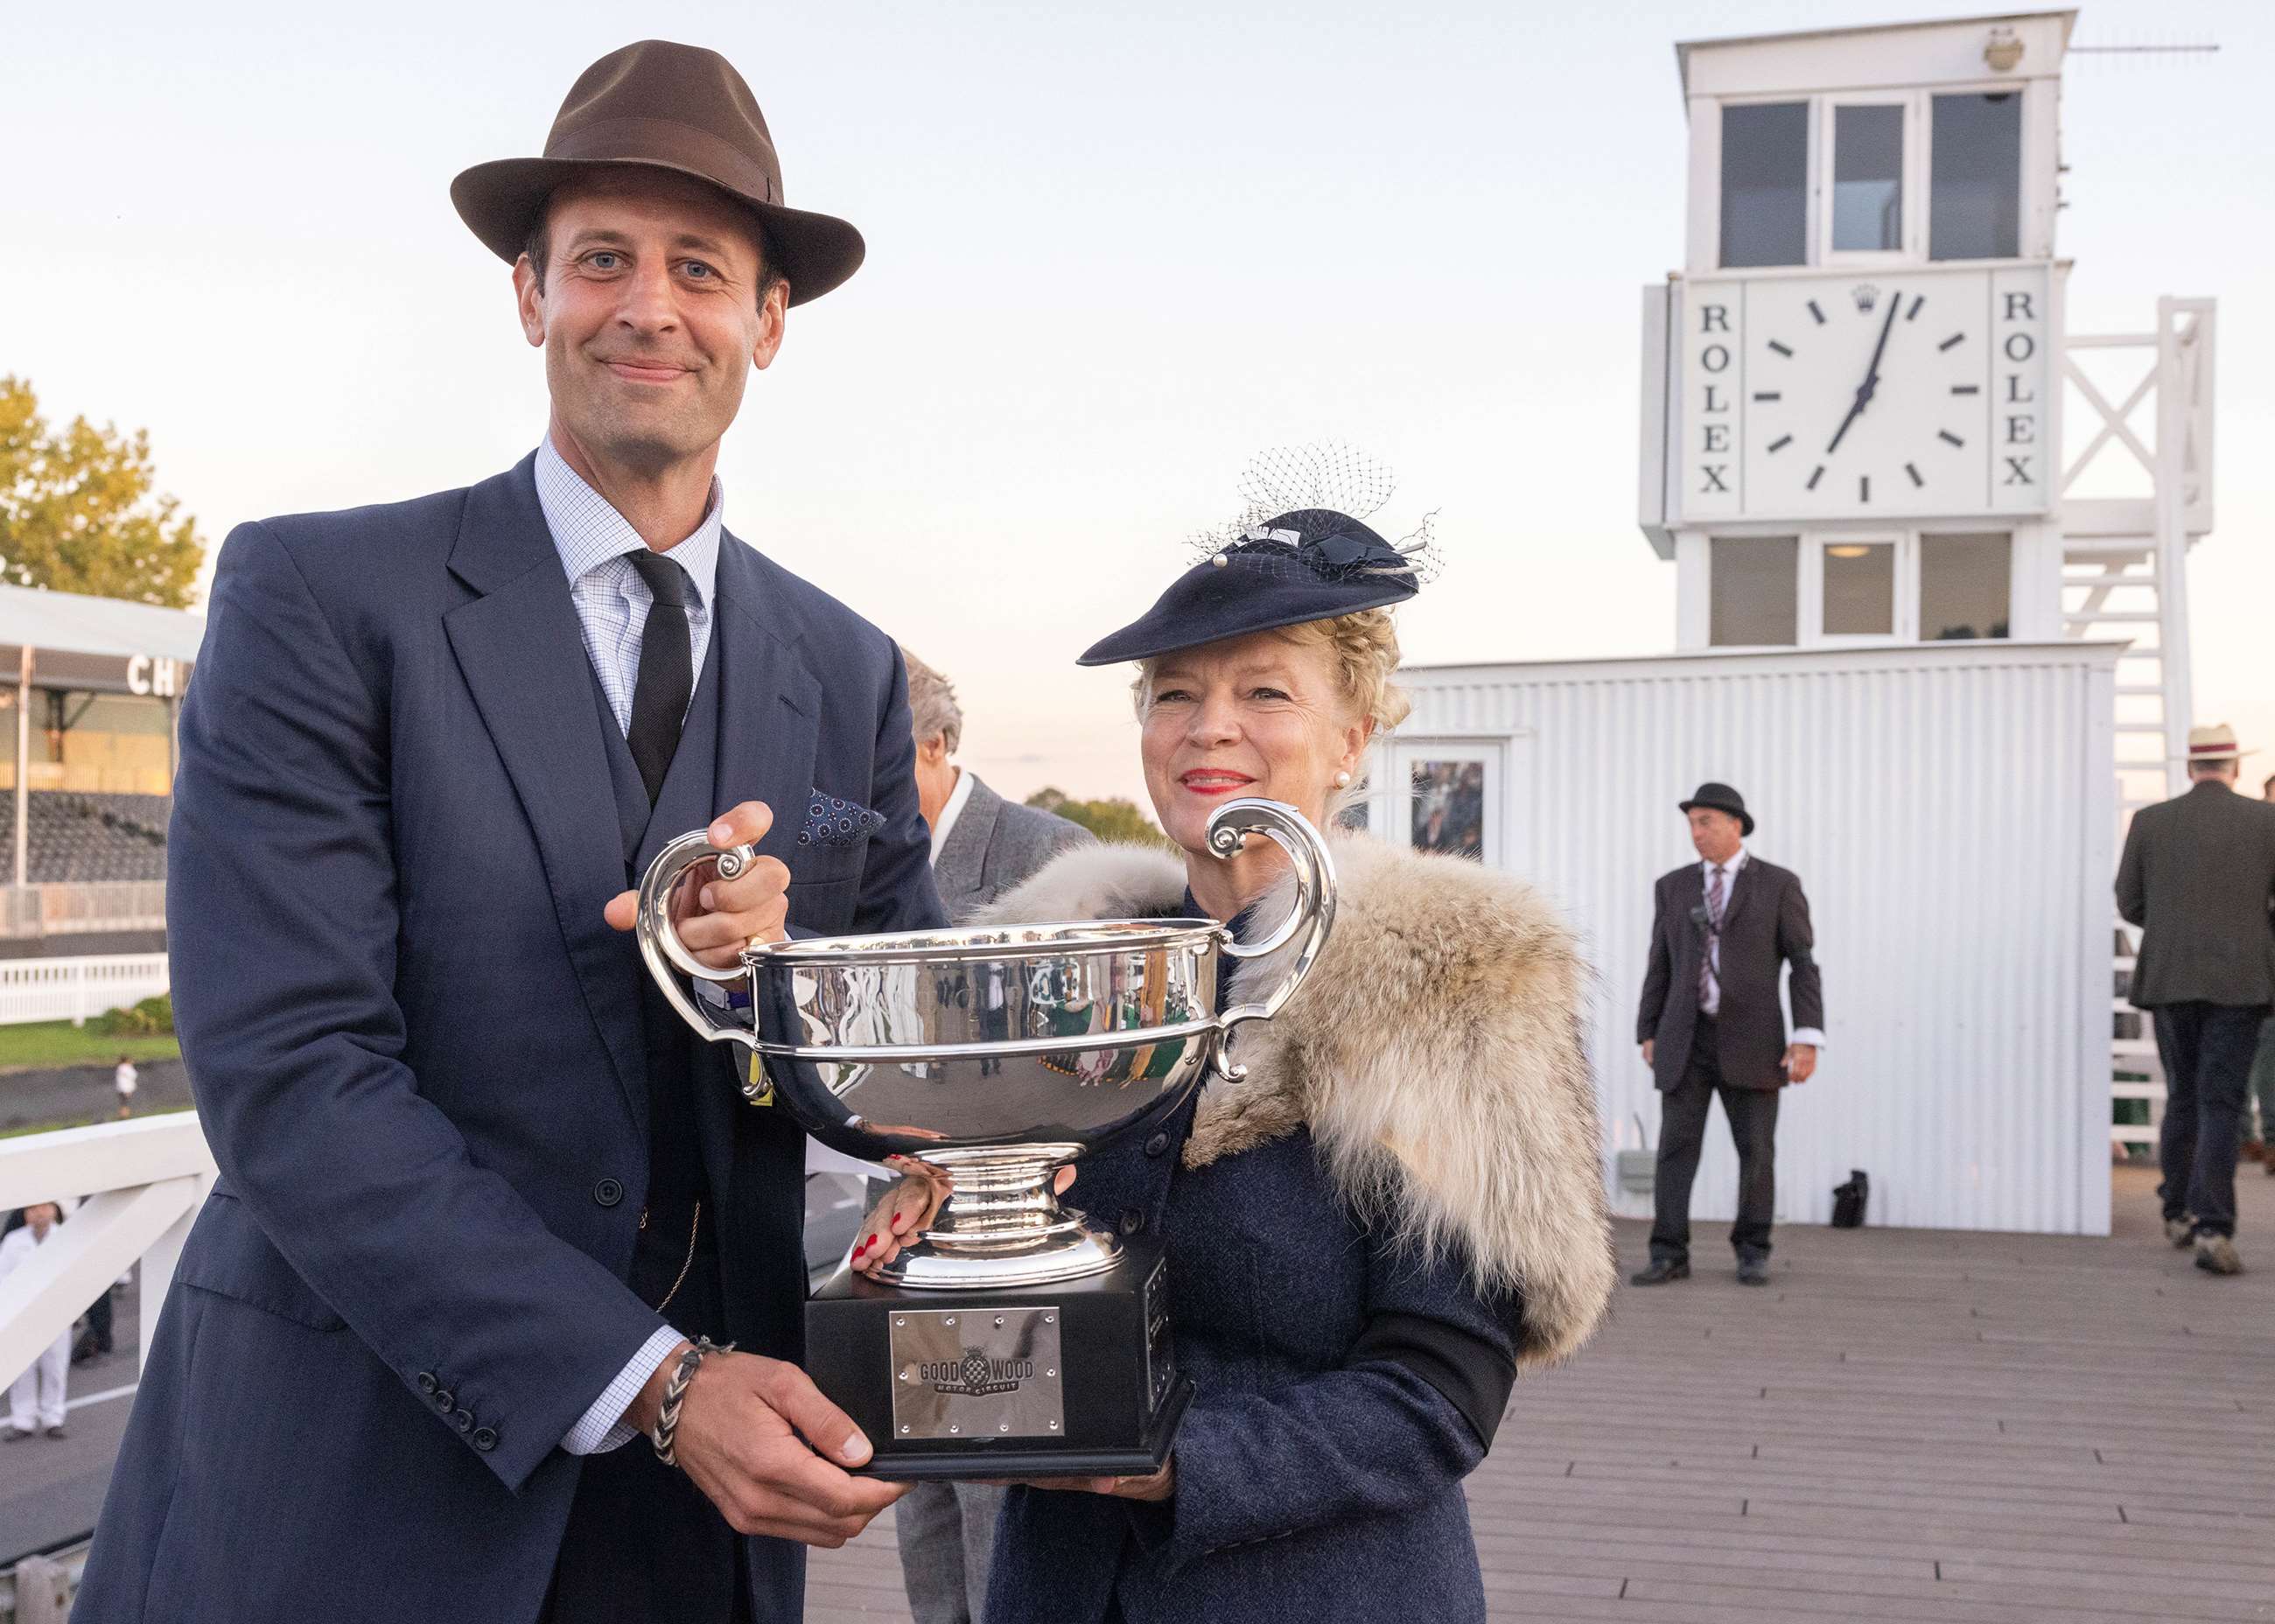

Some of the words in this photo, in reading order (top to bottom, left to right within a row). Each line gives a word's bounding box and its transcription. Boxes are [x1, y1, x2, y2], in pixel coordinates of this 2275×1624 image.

[1699, 304, 1731, 494] ROLEX
[2003, 290, 2035, 486] ROLEX
[937, 1384, 971, 1393] MOTOR
[975, 1382, 1017, 1395] CIRCUIT
